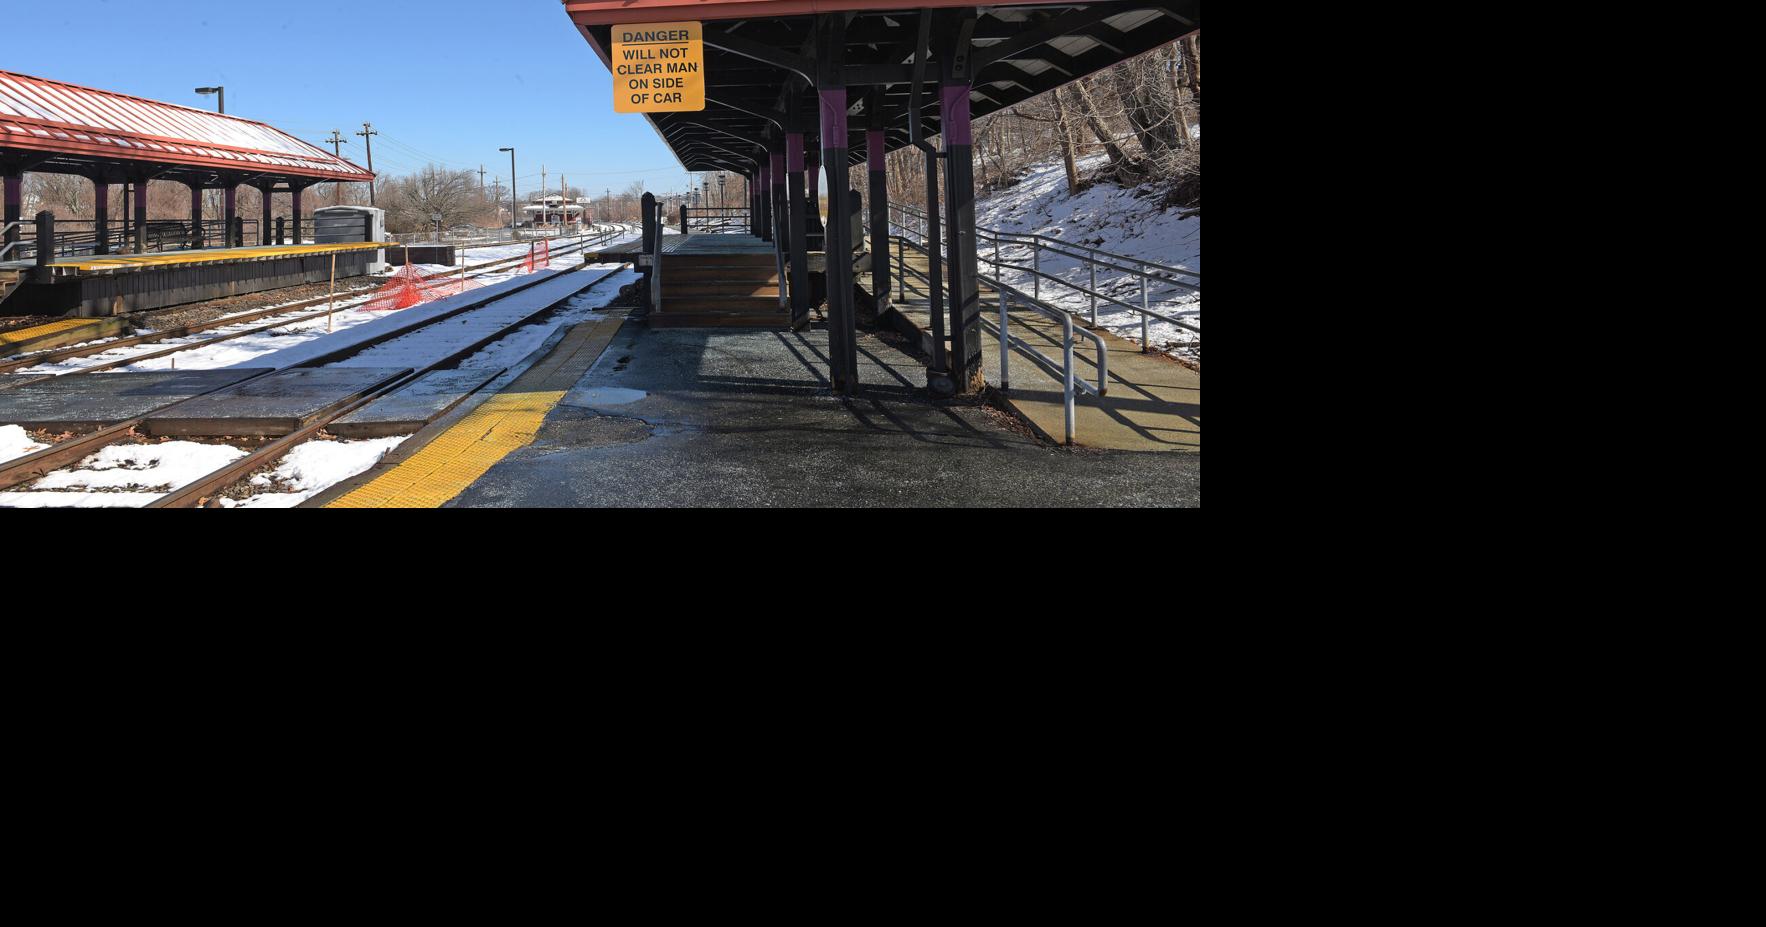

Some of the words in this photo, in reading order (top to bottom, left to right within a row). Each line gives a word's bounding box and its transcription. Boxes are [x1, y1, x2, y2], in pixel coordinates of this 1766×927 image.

[622, 30, 689, 42] DANGER
[622, 49, 655, 60] WILL
[659, 47, 688, 59] NOT
[617, 63, 662, 75] CLEAR
[666, 62, 698, 73] MAN
[628, 79, 648, 89] ON
[652, 77, 684, 89] SIDE
[630, 93, 649, 104] OF
[653, 92, 682, 103] CAR
